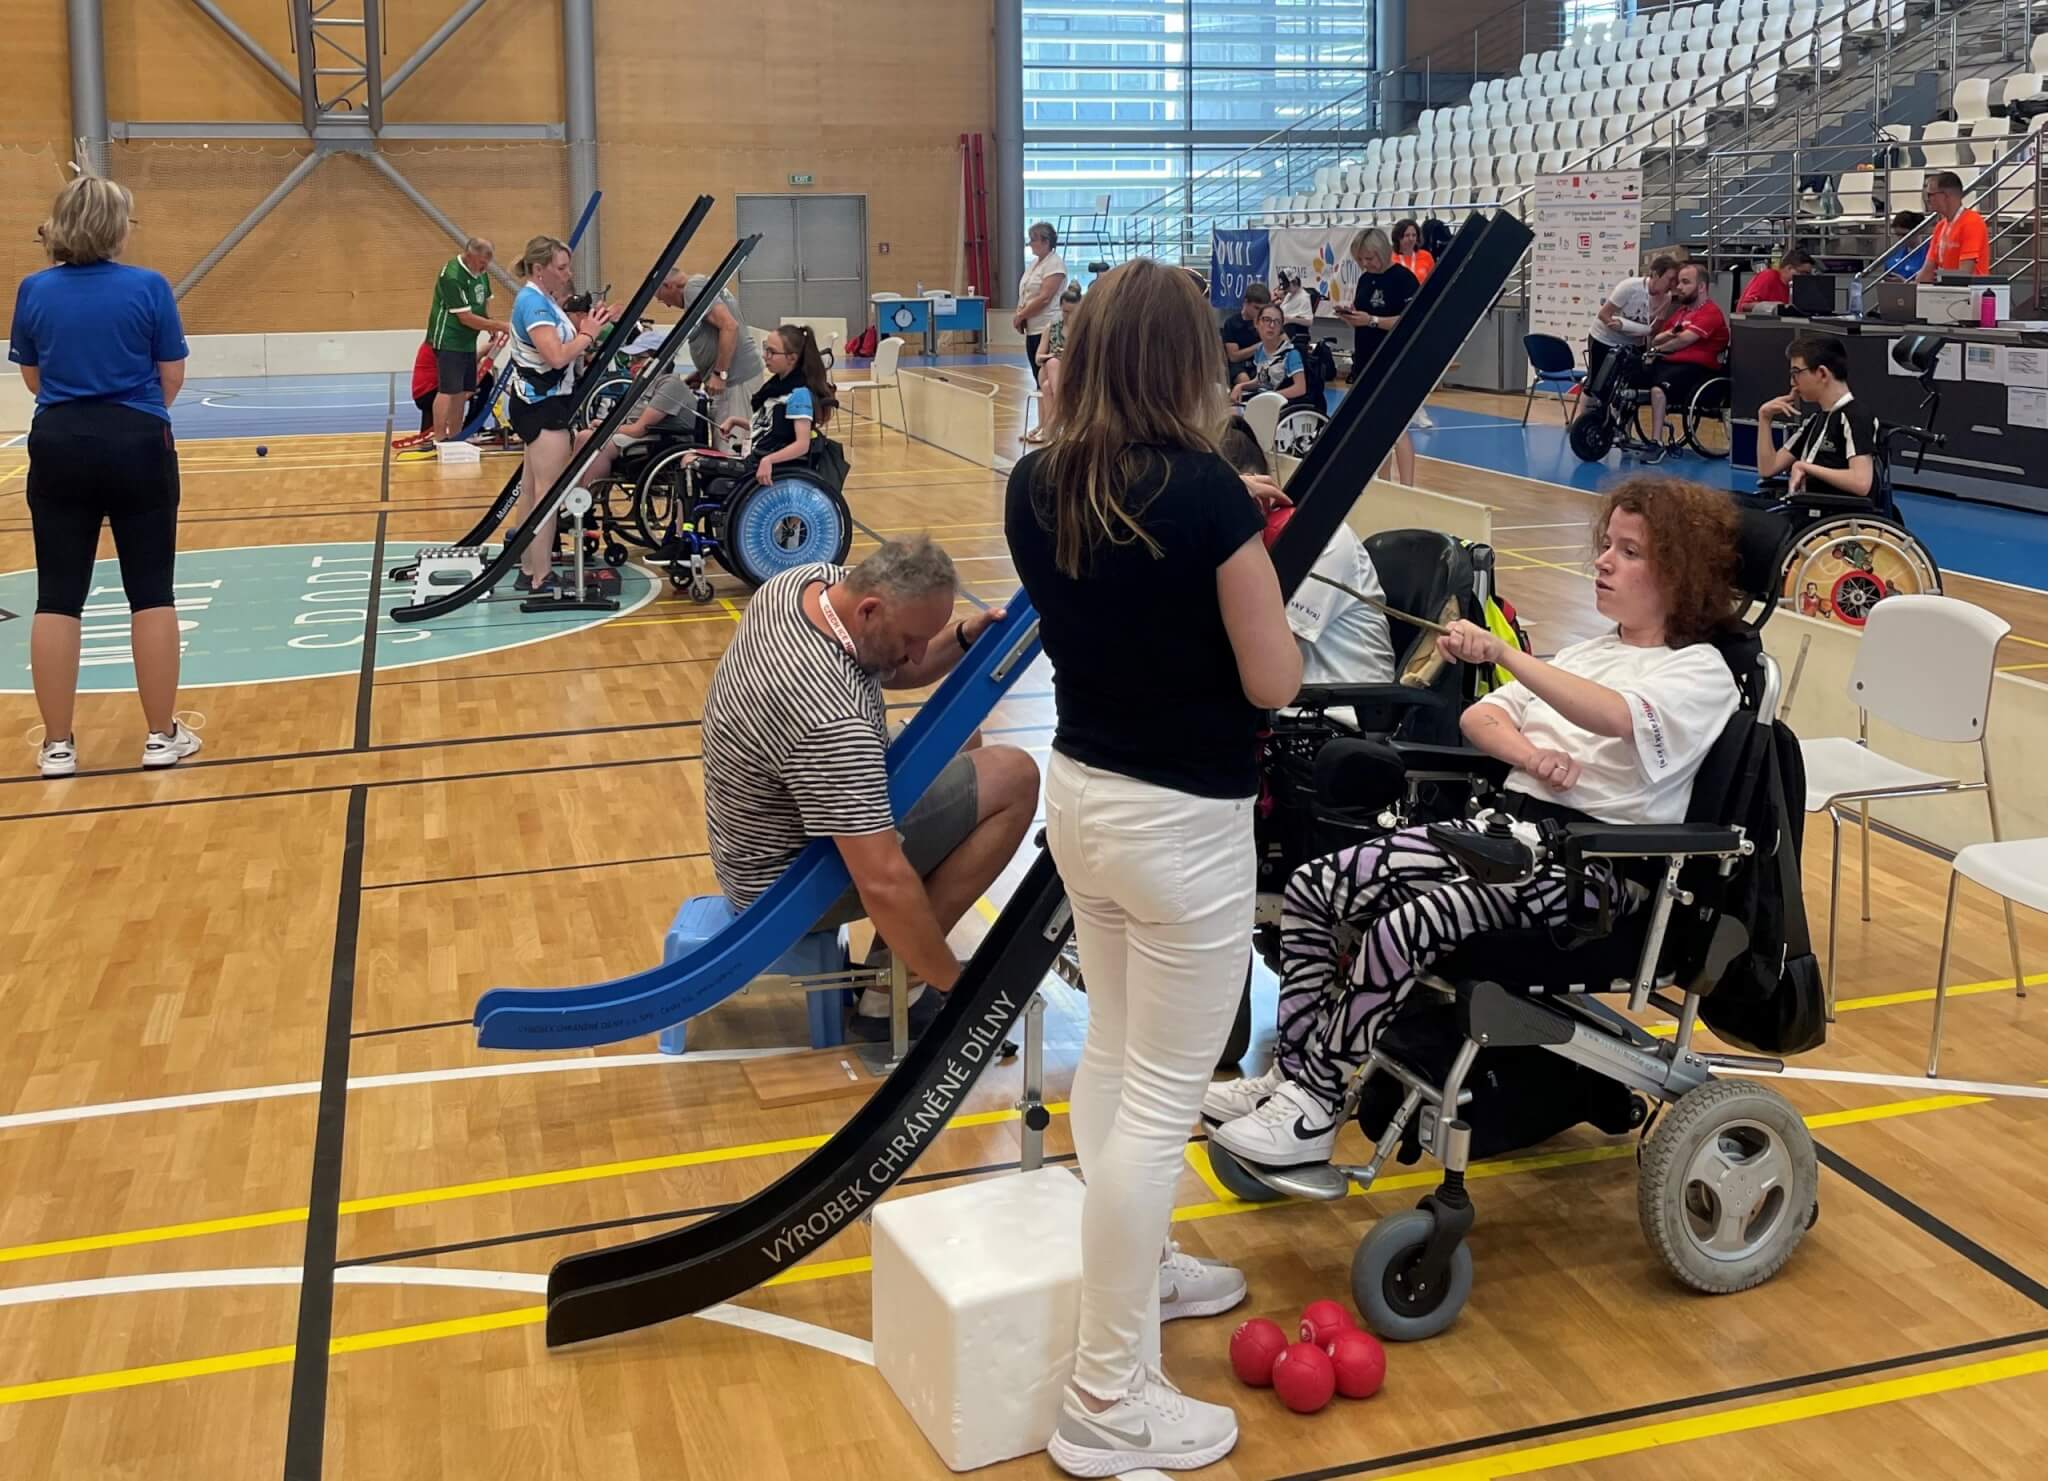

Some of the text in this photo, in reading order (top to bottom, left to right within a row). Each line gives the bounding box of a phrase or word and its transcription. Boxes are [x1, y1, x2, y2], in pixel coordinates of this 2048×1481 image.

[761, 990, 1017, 1266] VÝROBEK CHRÁNĚNÉ DÍLNY
